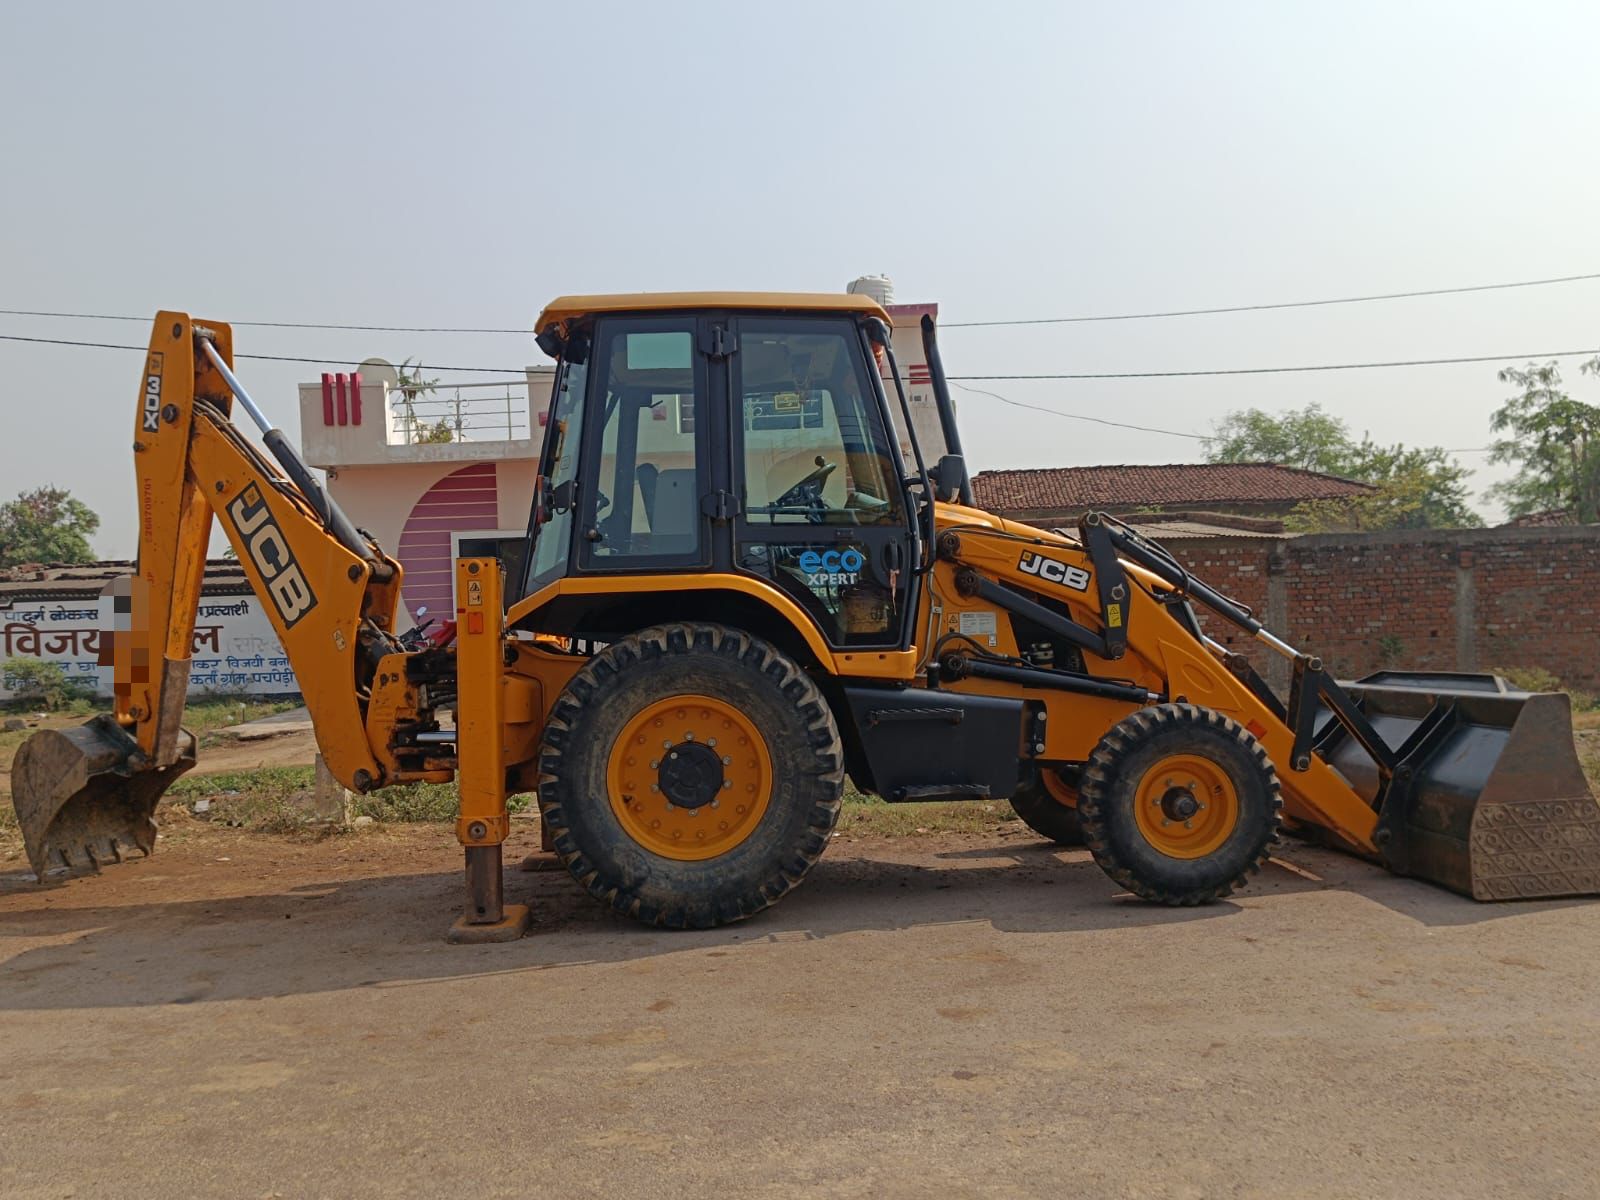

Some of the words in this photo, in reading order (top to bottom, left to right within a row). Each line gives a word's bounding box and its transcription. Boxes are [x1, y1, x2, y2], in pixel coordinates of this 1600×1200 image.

[144, 376, 160, 429] 3DX
[231, 498, 311, 621] JCB
[800, 550, 862, 573] eco
[808, 573, 857, 585] XPERT
[1019, 555, 1089, 590] JCB
[206, 600, 249, 617] प्रत्याशी
[225, 655, 265, 668] विजयी
[268, 658, 289, 667] बना
[252, 669, 295, 687] पचपेड़ी
